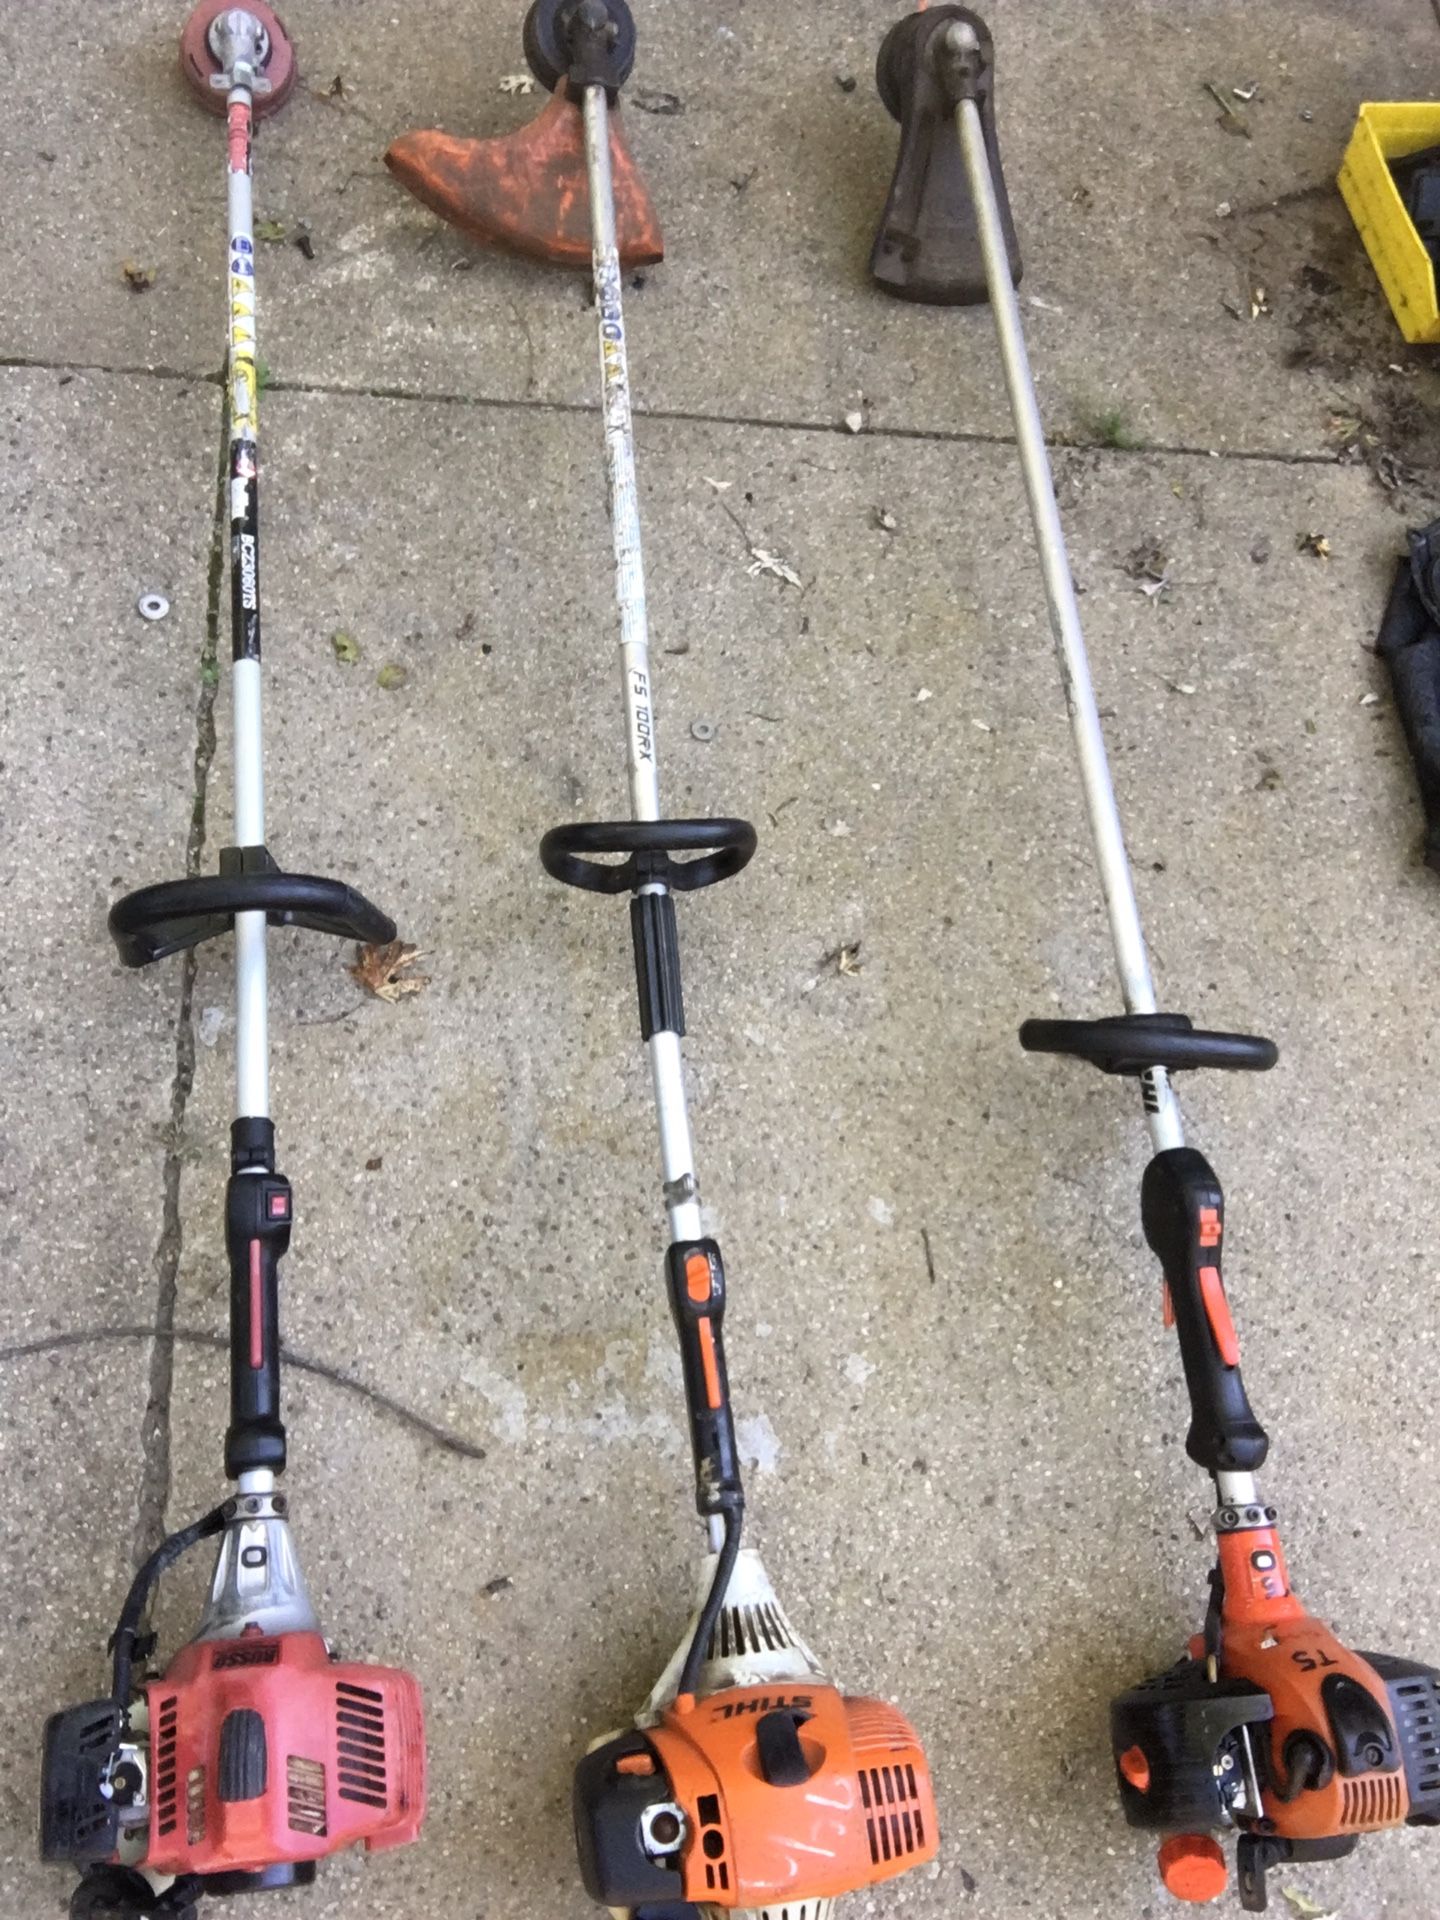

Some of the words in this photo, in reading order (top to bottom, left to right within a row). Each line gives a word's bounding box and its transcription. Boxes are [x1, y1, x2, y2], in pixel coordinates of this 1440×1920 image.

[633, 670, 648, 699] FS
[635, 704, 653, 764] 100RX
[712, 1696, 813, 1719] STIHL
